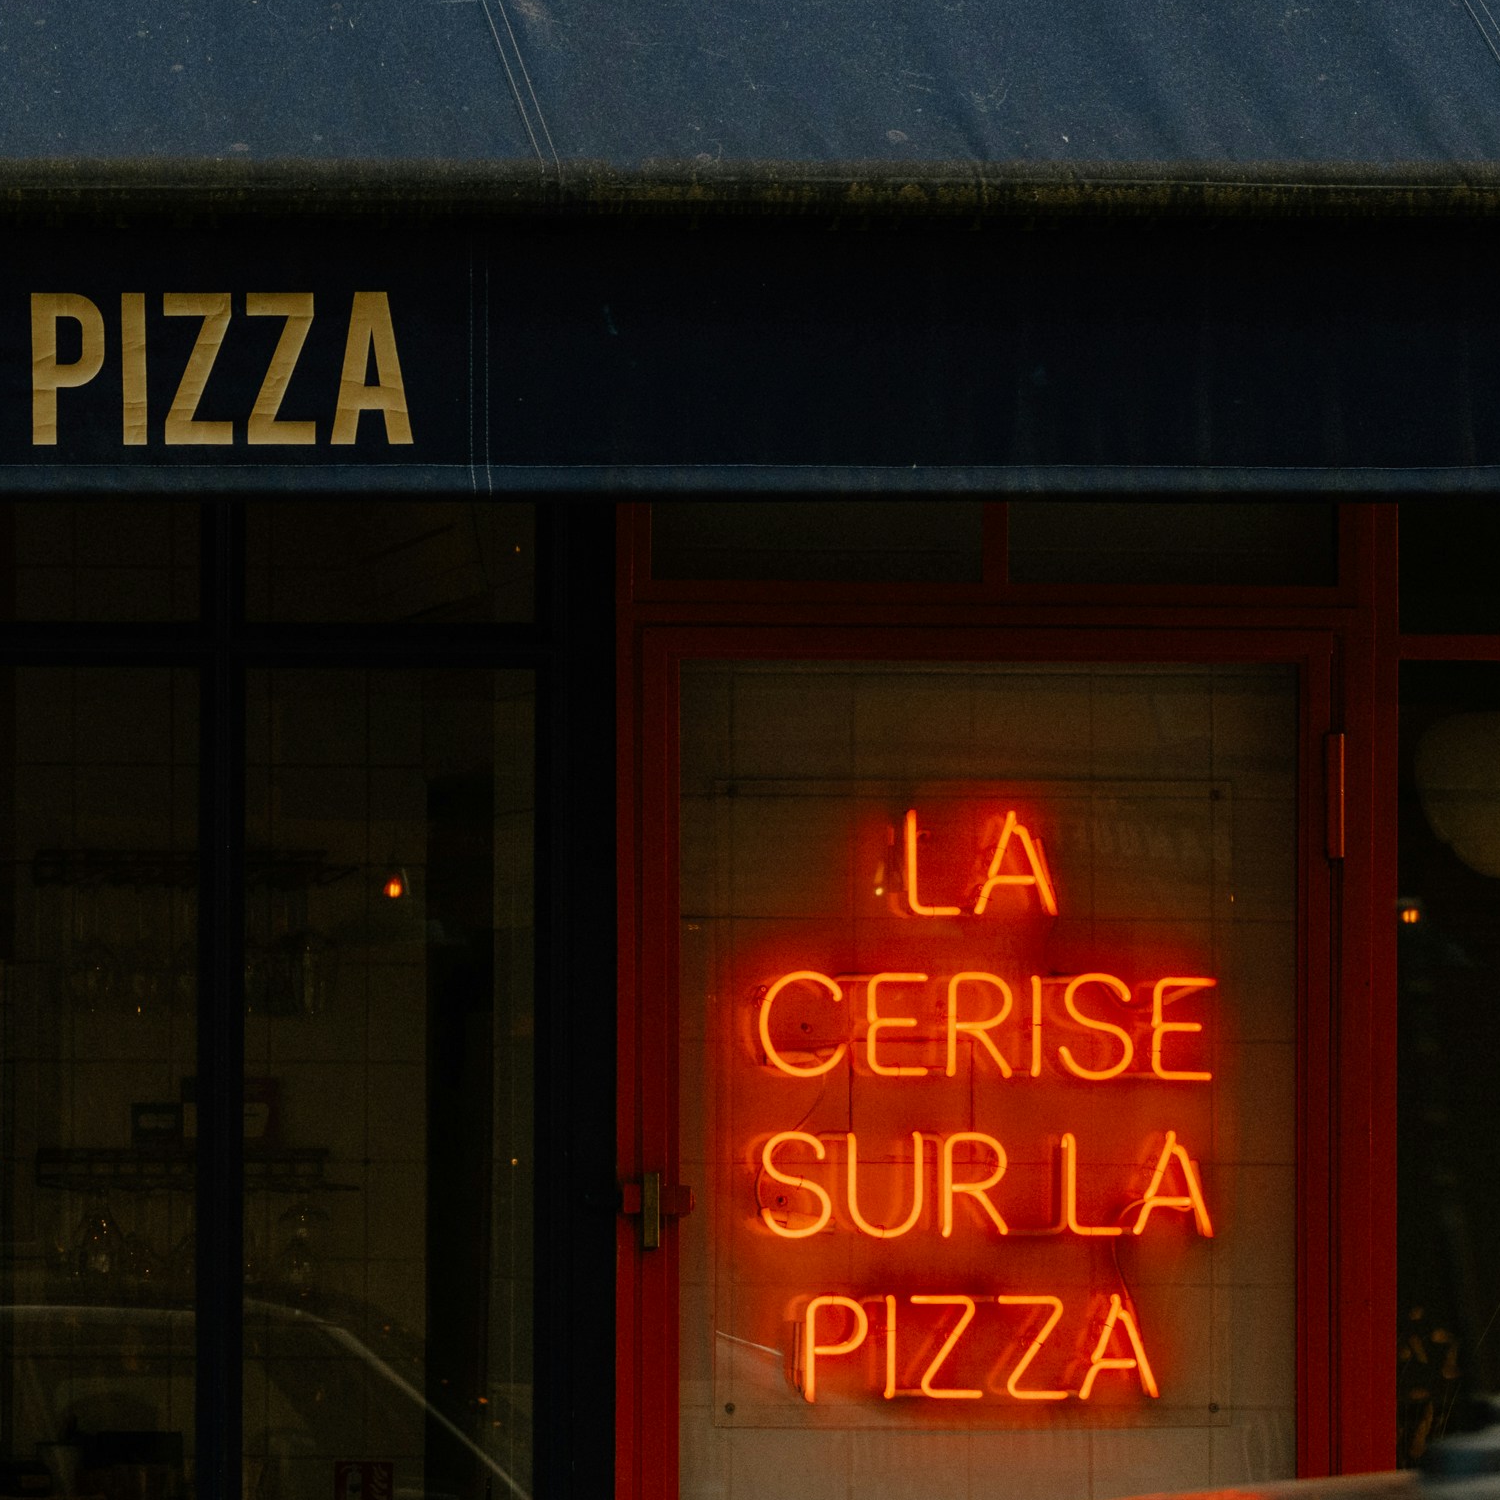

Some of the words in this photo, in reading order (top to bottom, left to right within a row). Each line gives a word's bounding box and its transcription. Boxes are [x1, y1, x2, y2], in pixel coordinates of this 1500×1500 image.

[30, 291, 413, 445] PIZZA
[905, 808, 1059, 916] LA
[758, 970, 1217, 1082] CERISE
[760, 1130, 1009, 1239] SUR
[1061, 1130, 1214, 1239] LA
[804, 1293, 1160, 1403] PIZZA
